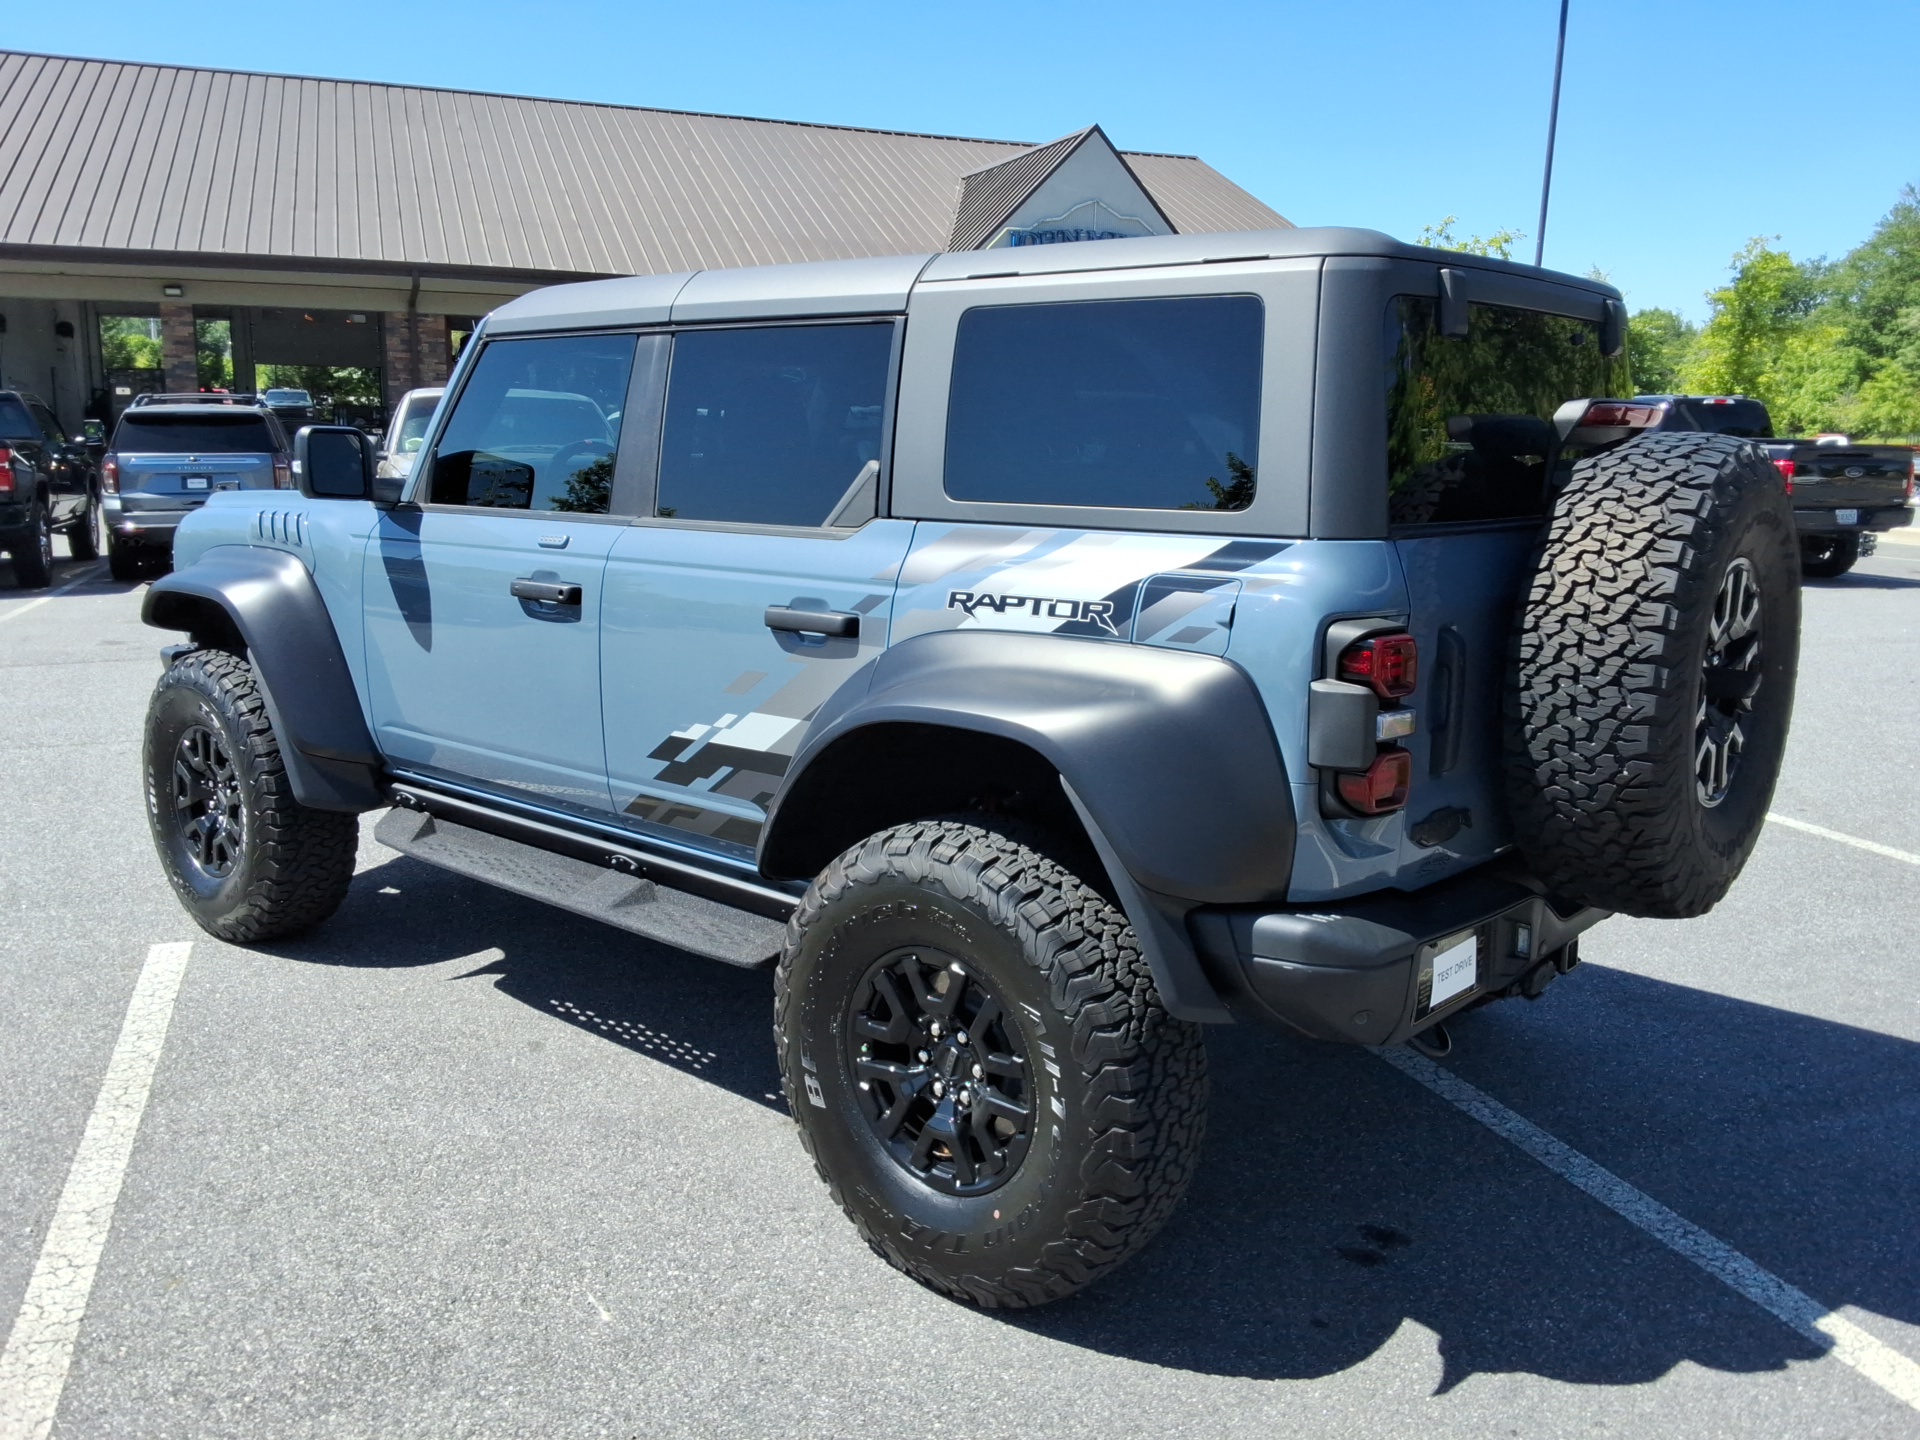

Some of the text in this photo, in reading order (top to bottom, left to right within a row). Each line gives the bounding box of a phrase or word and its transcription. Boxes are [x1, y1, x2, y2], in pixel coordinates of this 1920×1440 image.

[947, 590, 1118, 636] RAPTOR
[1437, 954, 1473, 983] TEST DRIVE
